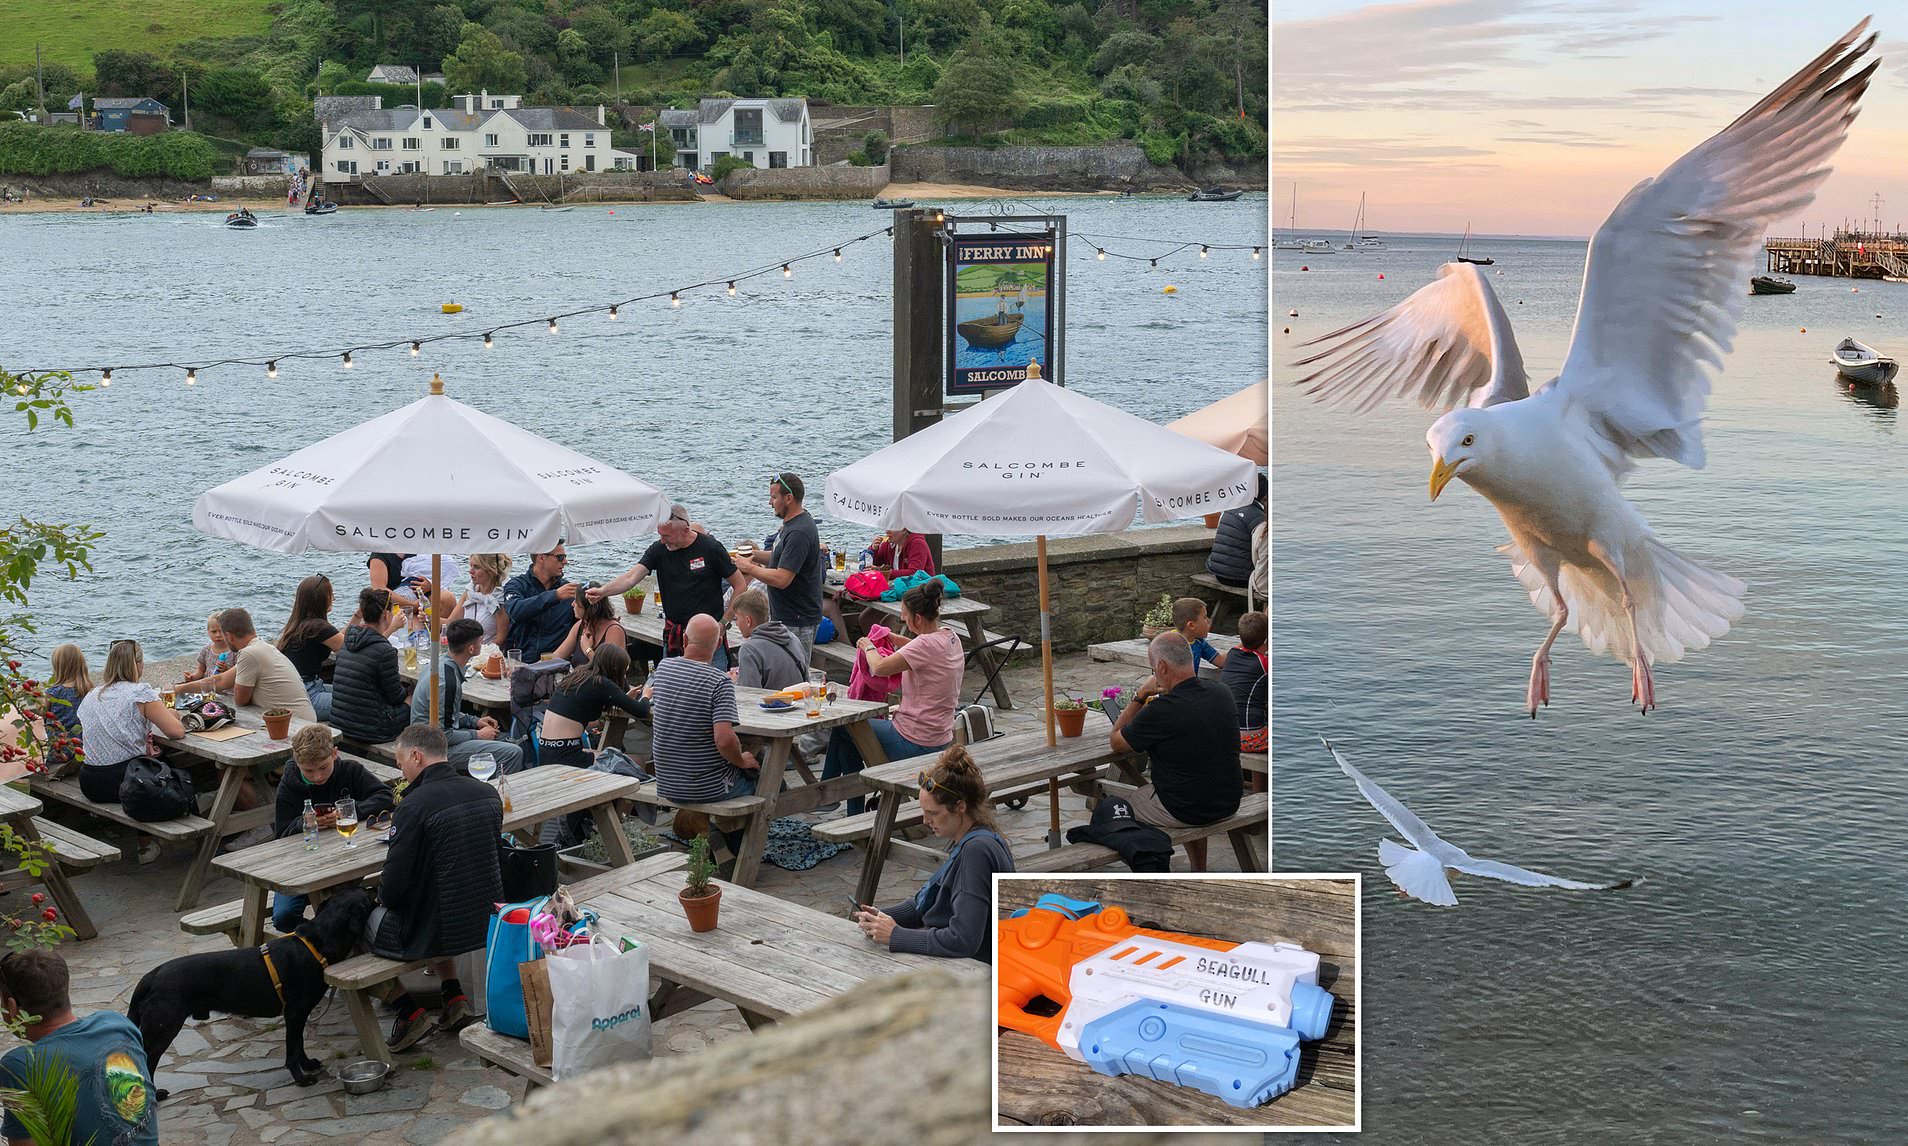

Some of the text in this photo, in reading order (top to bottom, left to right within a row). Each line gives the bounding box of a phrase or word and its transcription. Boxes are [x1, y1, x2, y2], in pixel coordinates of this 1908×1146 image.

[964, 247, 1013, 260] FERRY
[1016, 246, 1044, 259] INN
[967, 370, 1028, 382] SALCOMB
[961, 461, 1086, 469] SALCOMBE
[270, 467, 335, 485] SALCOMBE
[537, 467, 601, 479] SALCOMBE
[275, 480, 299, 489] GIN
[570, 478, 593, 486] GIN
[1217, 483, 1247, 499] GIN
[335, 524, 529, 540] SALCOMBE GIN
[1197, 957, 1270, 986] SEAGULL
[1199, 988, 1237, 1009] GUN
[591, 1004, 641, 1032] Apparel
